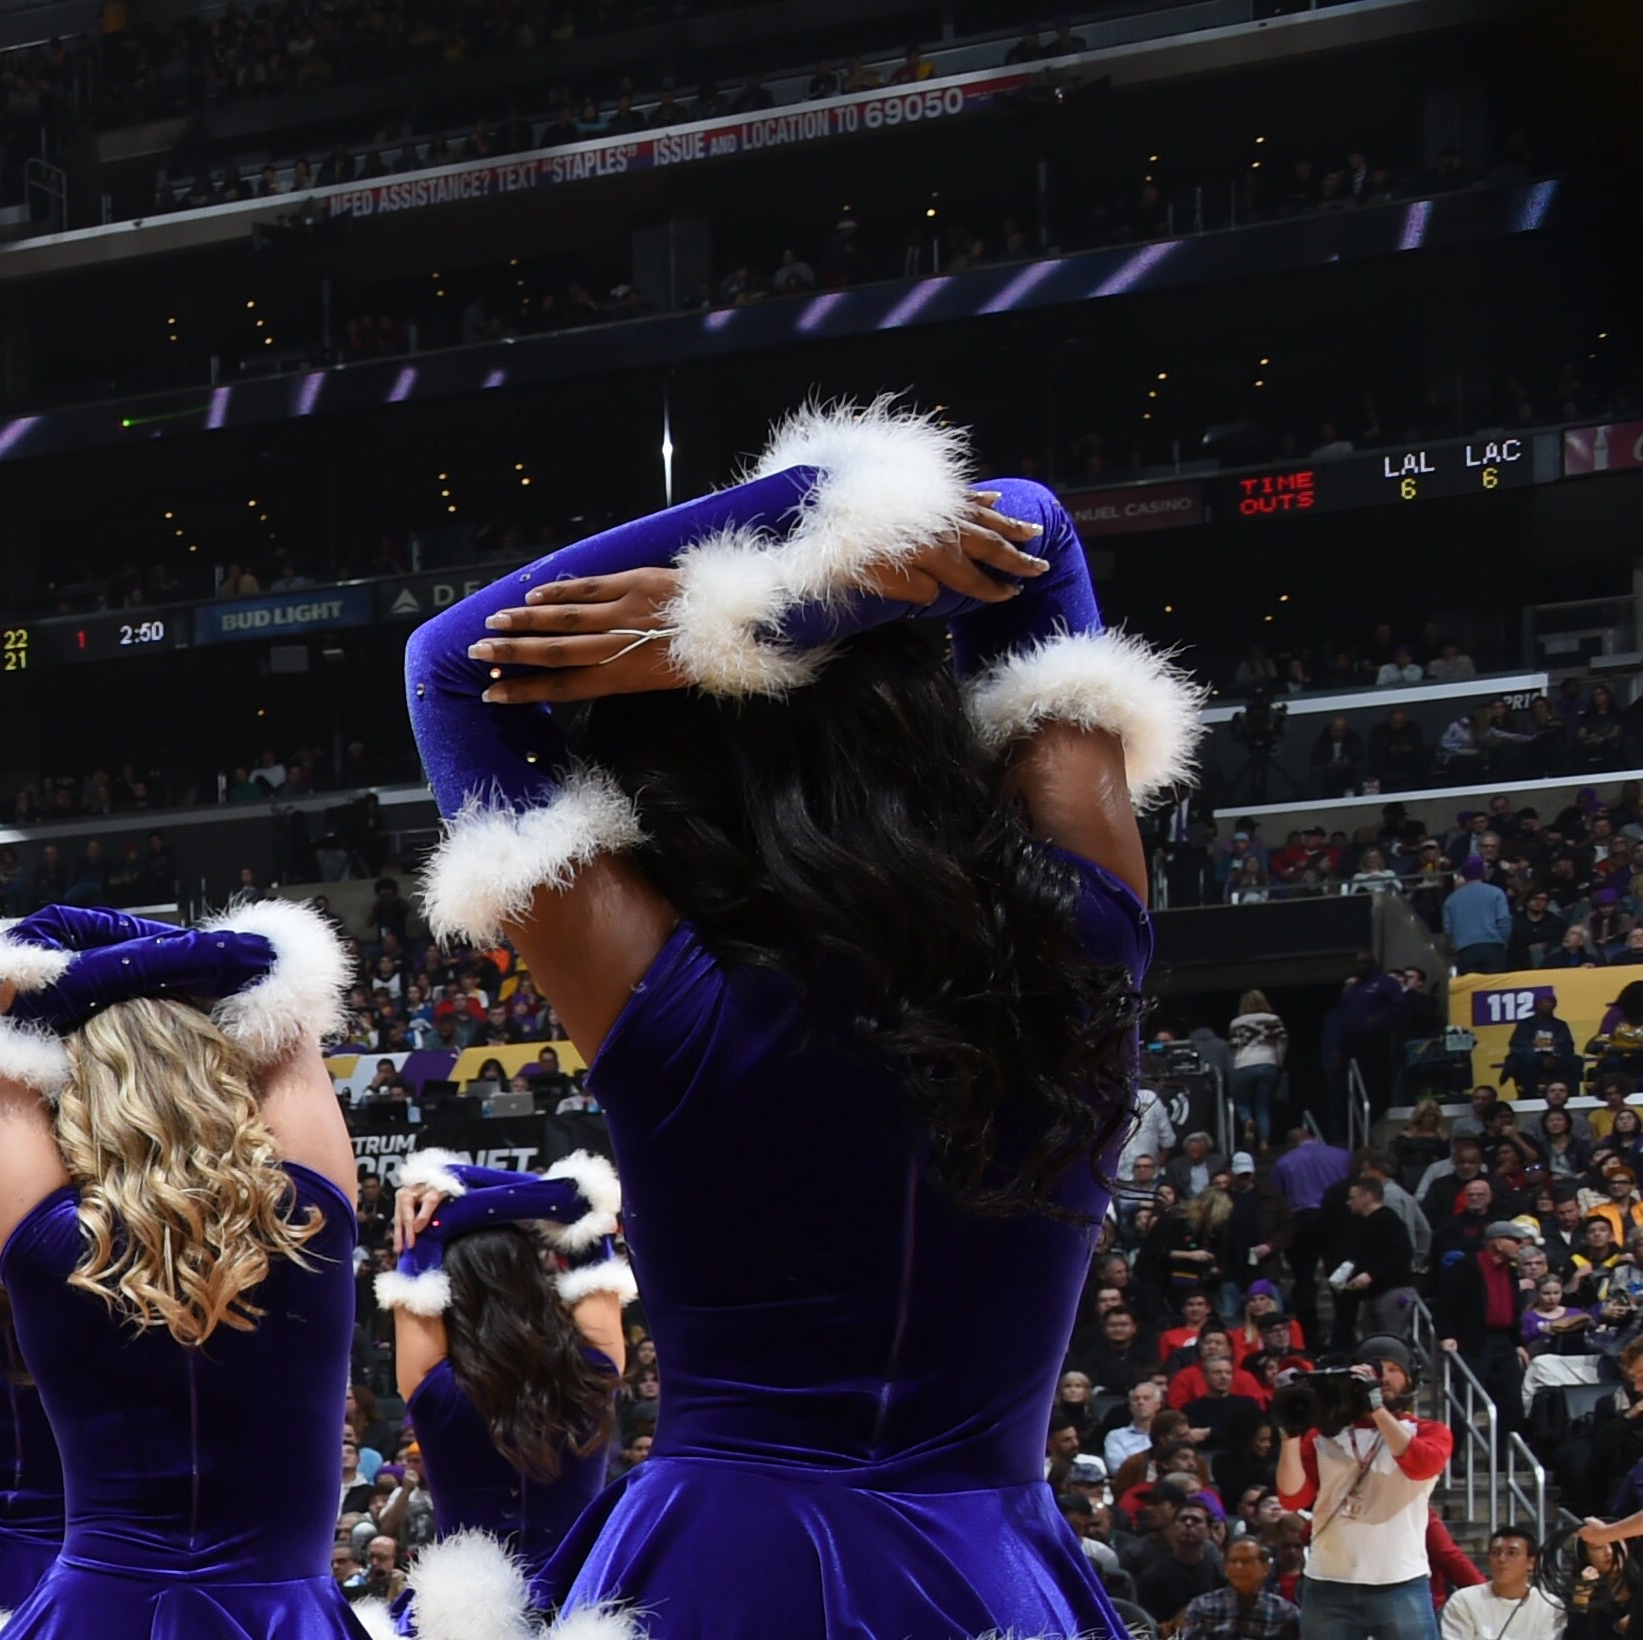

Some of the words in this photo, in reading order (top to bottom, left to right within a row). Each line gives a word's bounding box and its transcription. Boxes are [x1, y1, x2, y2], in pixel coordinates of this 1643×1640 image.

[377, 170, 491, 213] ASSISTANCE?
[496, 161, 538, 192] TEXT
[653, 132, 705, 166] ISSUE
[710, 135, 736, 156] AND
[741, 111, 830, 151] LOCATION
[835, 105, 858, 133] TO
[864, 87, 964, 128] 69050
[1384, 451, 1435, 478] LAL
[1465, 438, 1521, 468] LAC
[1240, 471, 1314, 495] TIME
[1400, 477, 1418, 499] 6
[1482, 467, 1499, 489] 6
[1074, 503, 1121, 523] NUEL
[1125, 497, 1192, 518] CASINO
[1239, 490, 1315, 515] OUTS
[221, 611, 270, 630] BUD
[274, 600, 343, 626] LIGHT
[3, 628, 29, 650] 22
[77, 629, 87, 650] 1
[120, 620, 164, 646] 2:50
[3, 649, 28, 672] 21
[1487, 991, 1535, 1021] 112
